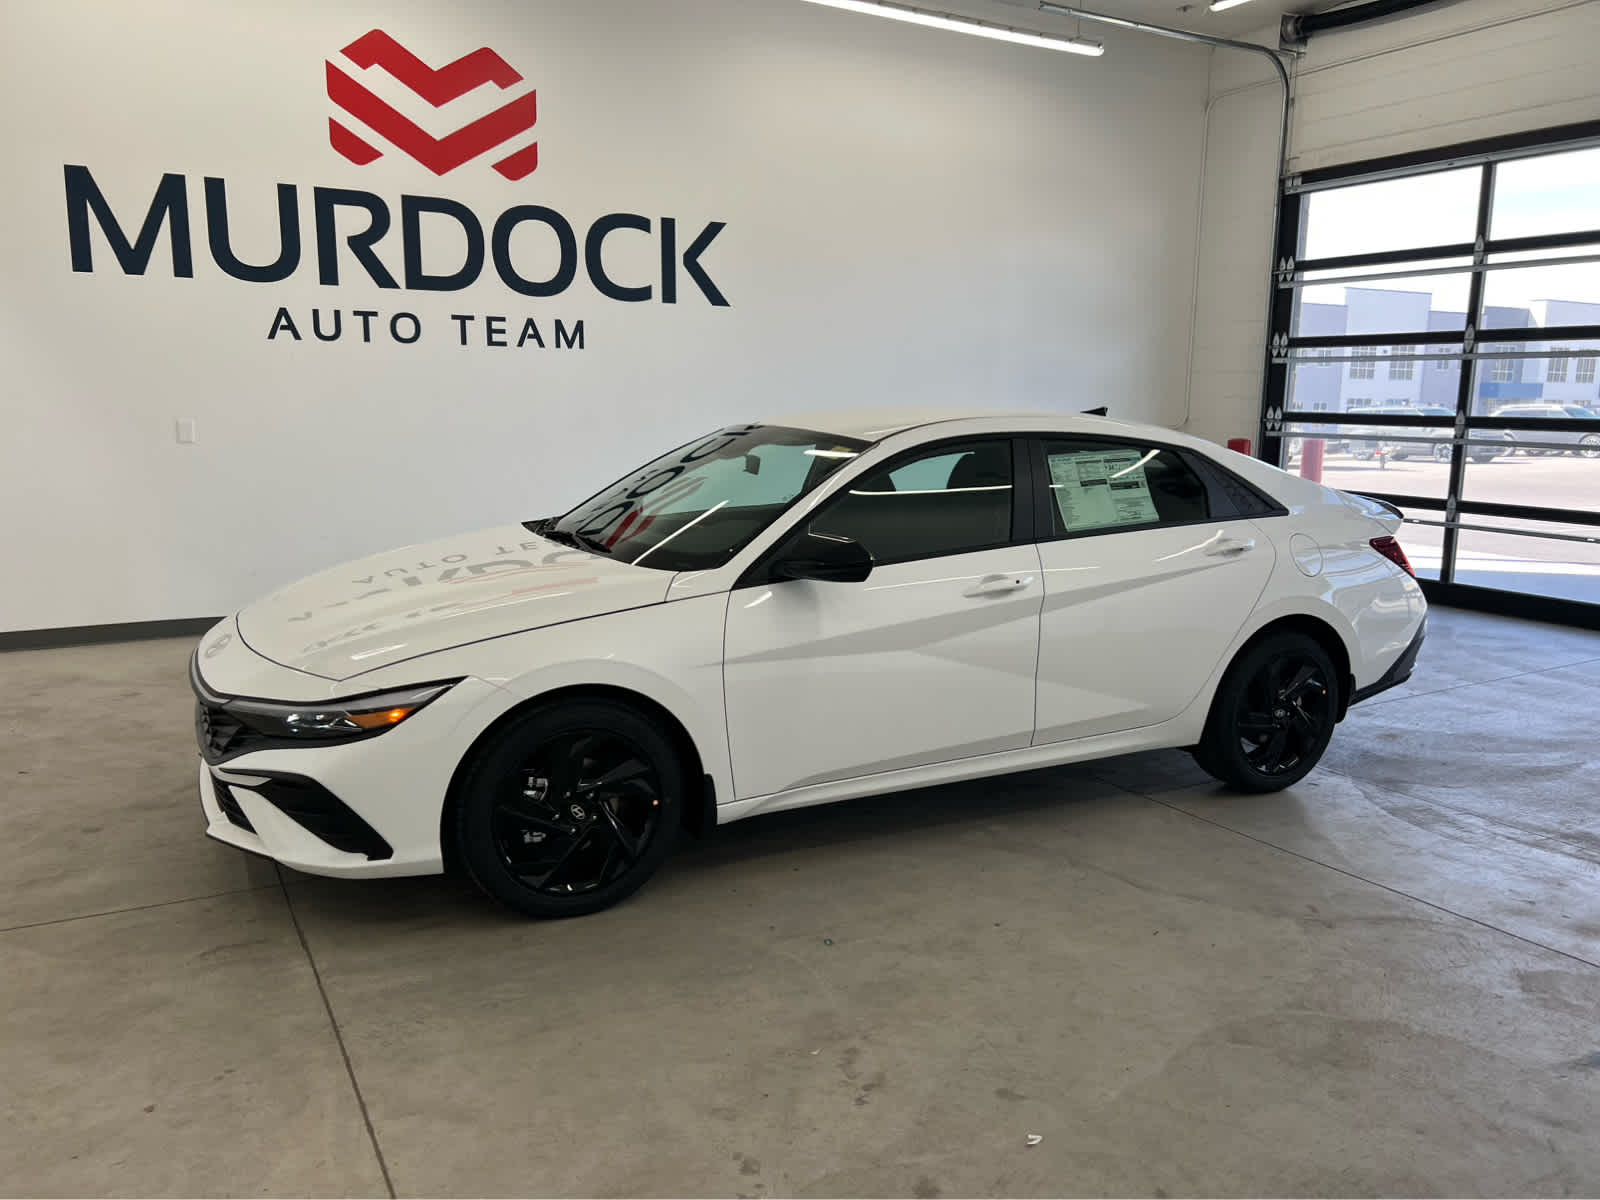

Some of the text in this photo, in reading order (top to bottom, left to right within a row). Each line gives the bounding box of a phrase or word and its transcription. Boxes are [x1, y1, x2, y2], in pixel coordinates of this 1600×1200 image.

[63, 164, 731, 307] MURDOCK
[267, 307, 586, 350] AUTO TEAM
